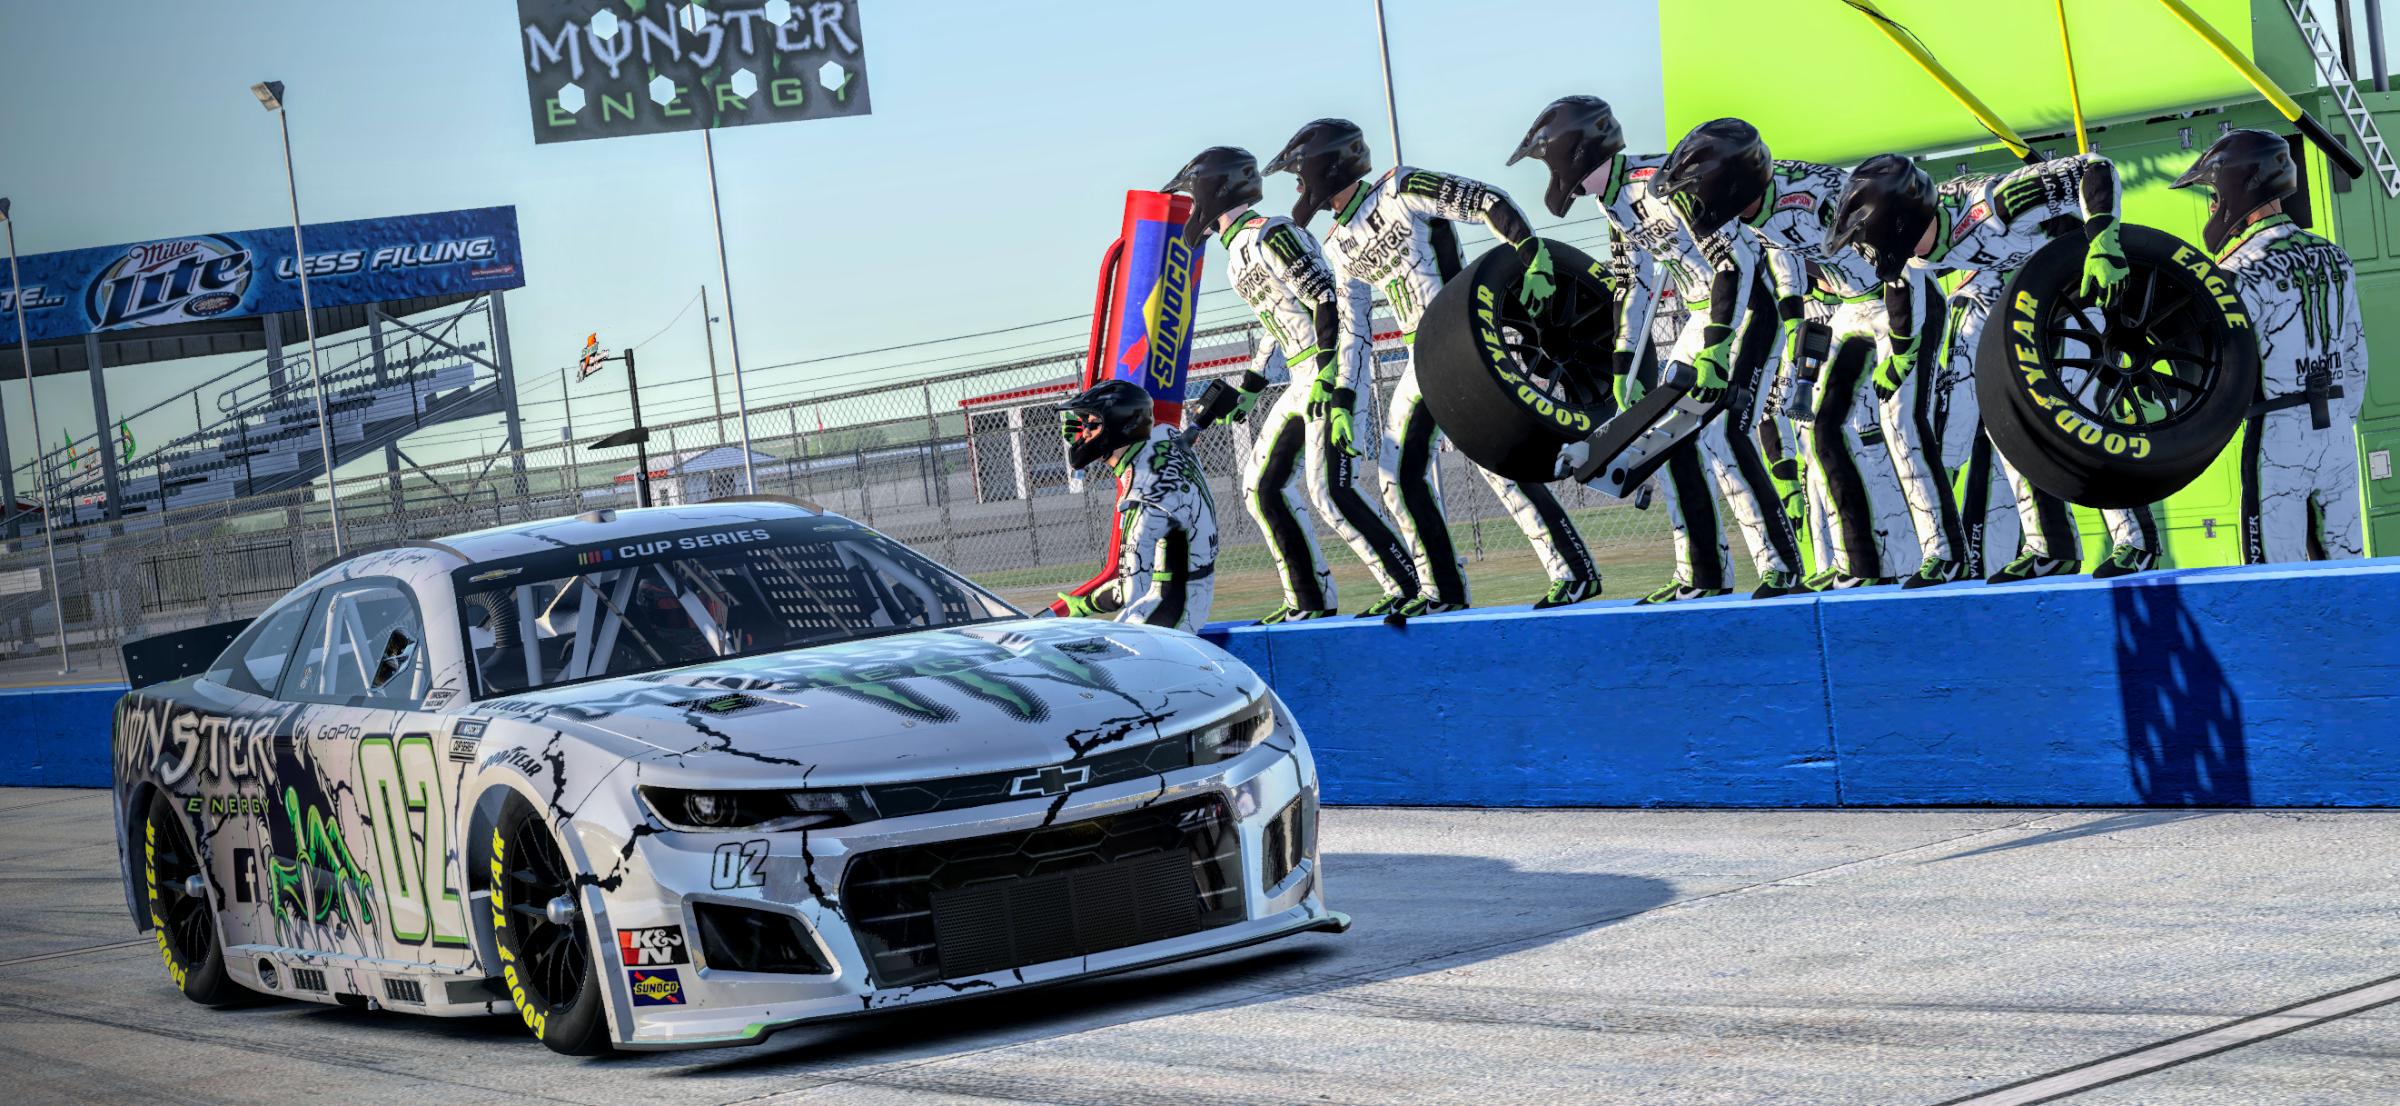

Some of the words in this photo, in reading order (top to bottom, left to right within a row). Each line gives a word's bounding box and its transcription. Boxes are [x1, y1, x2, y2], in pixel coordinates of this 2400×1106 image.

[525, 1, 858, 80] MONSTER
[546, 72, 853, 127] ENERGY
[129, 241, 201, 268] Miller
[278, 251, 364, 279] LESS
[371, 238, 496, 269] FILLING.
[1343, 220, 1411, 278] MONSTER
[92, 250, 251, 332] Lite
[2171, 245, 2249, 330] EAGLE
[1153, 247, 1191, 384] SUNOCO
[619, 541, 672, 559] CUP
[678, 529, 770, 550] SERIES
[118, 694, 277, 786] MONSTER
[317, 724, 361, 741] GoPro
[187, 797, 270, 814] ENERGY
[359, 733, 470, 949] 02
[711, 838, 771, 890] 02
[635, 981, 678, 994] SUNOCO
